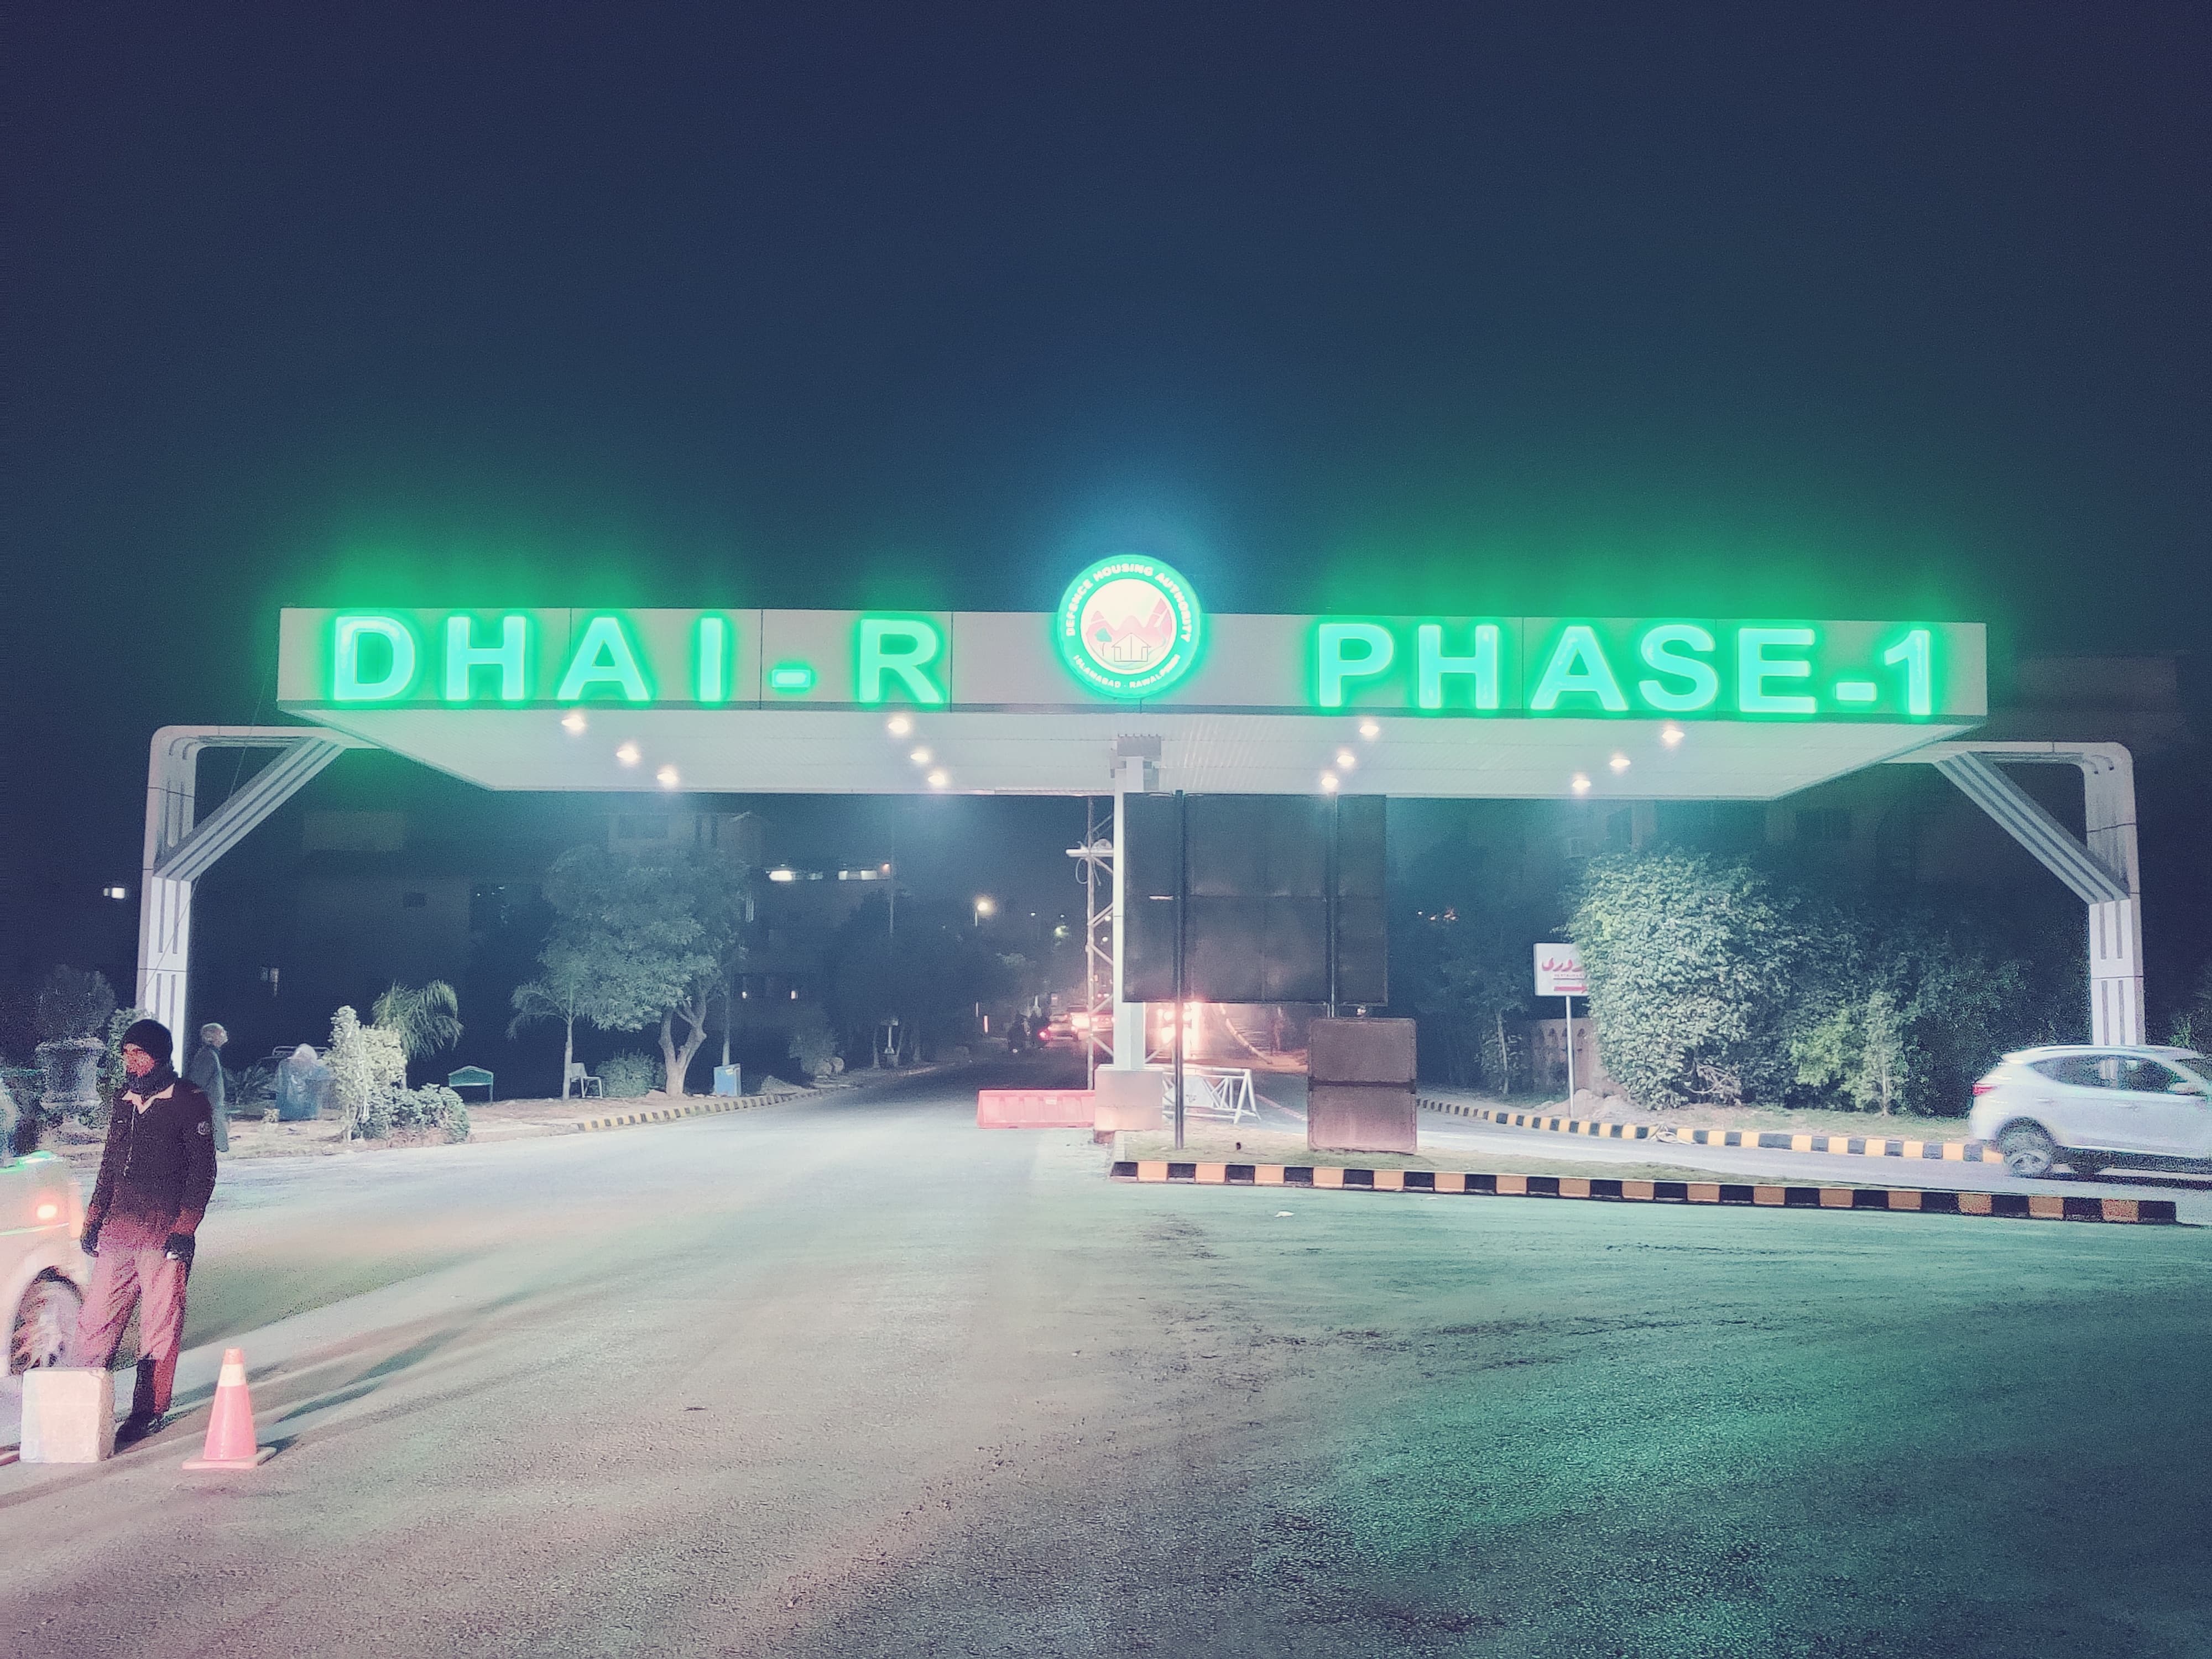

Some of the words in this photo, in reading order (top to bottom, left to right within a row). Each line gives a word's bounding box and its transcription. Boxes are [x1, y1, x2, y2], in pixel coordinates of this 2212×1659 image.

[1066, 579, 1093, 636] DEFENCE
[1093, 564, 1154, 580] HOUSING
[1155, 573, 1192, 642] AUTHORITY
[1129, 654, 1181, 688] RAWALP
[1318, 623, 1931, 716] PHASE-1
